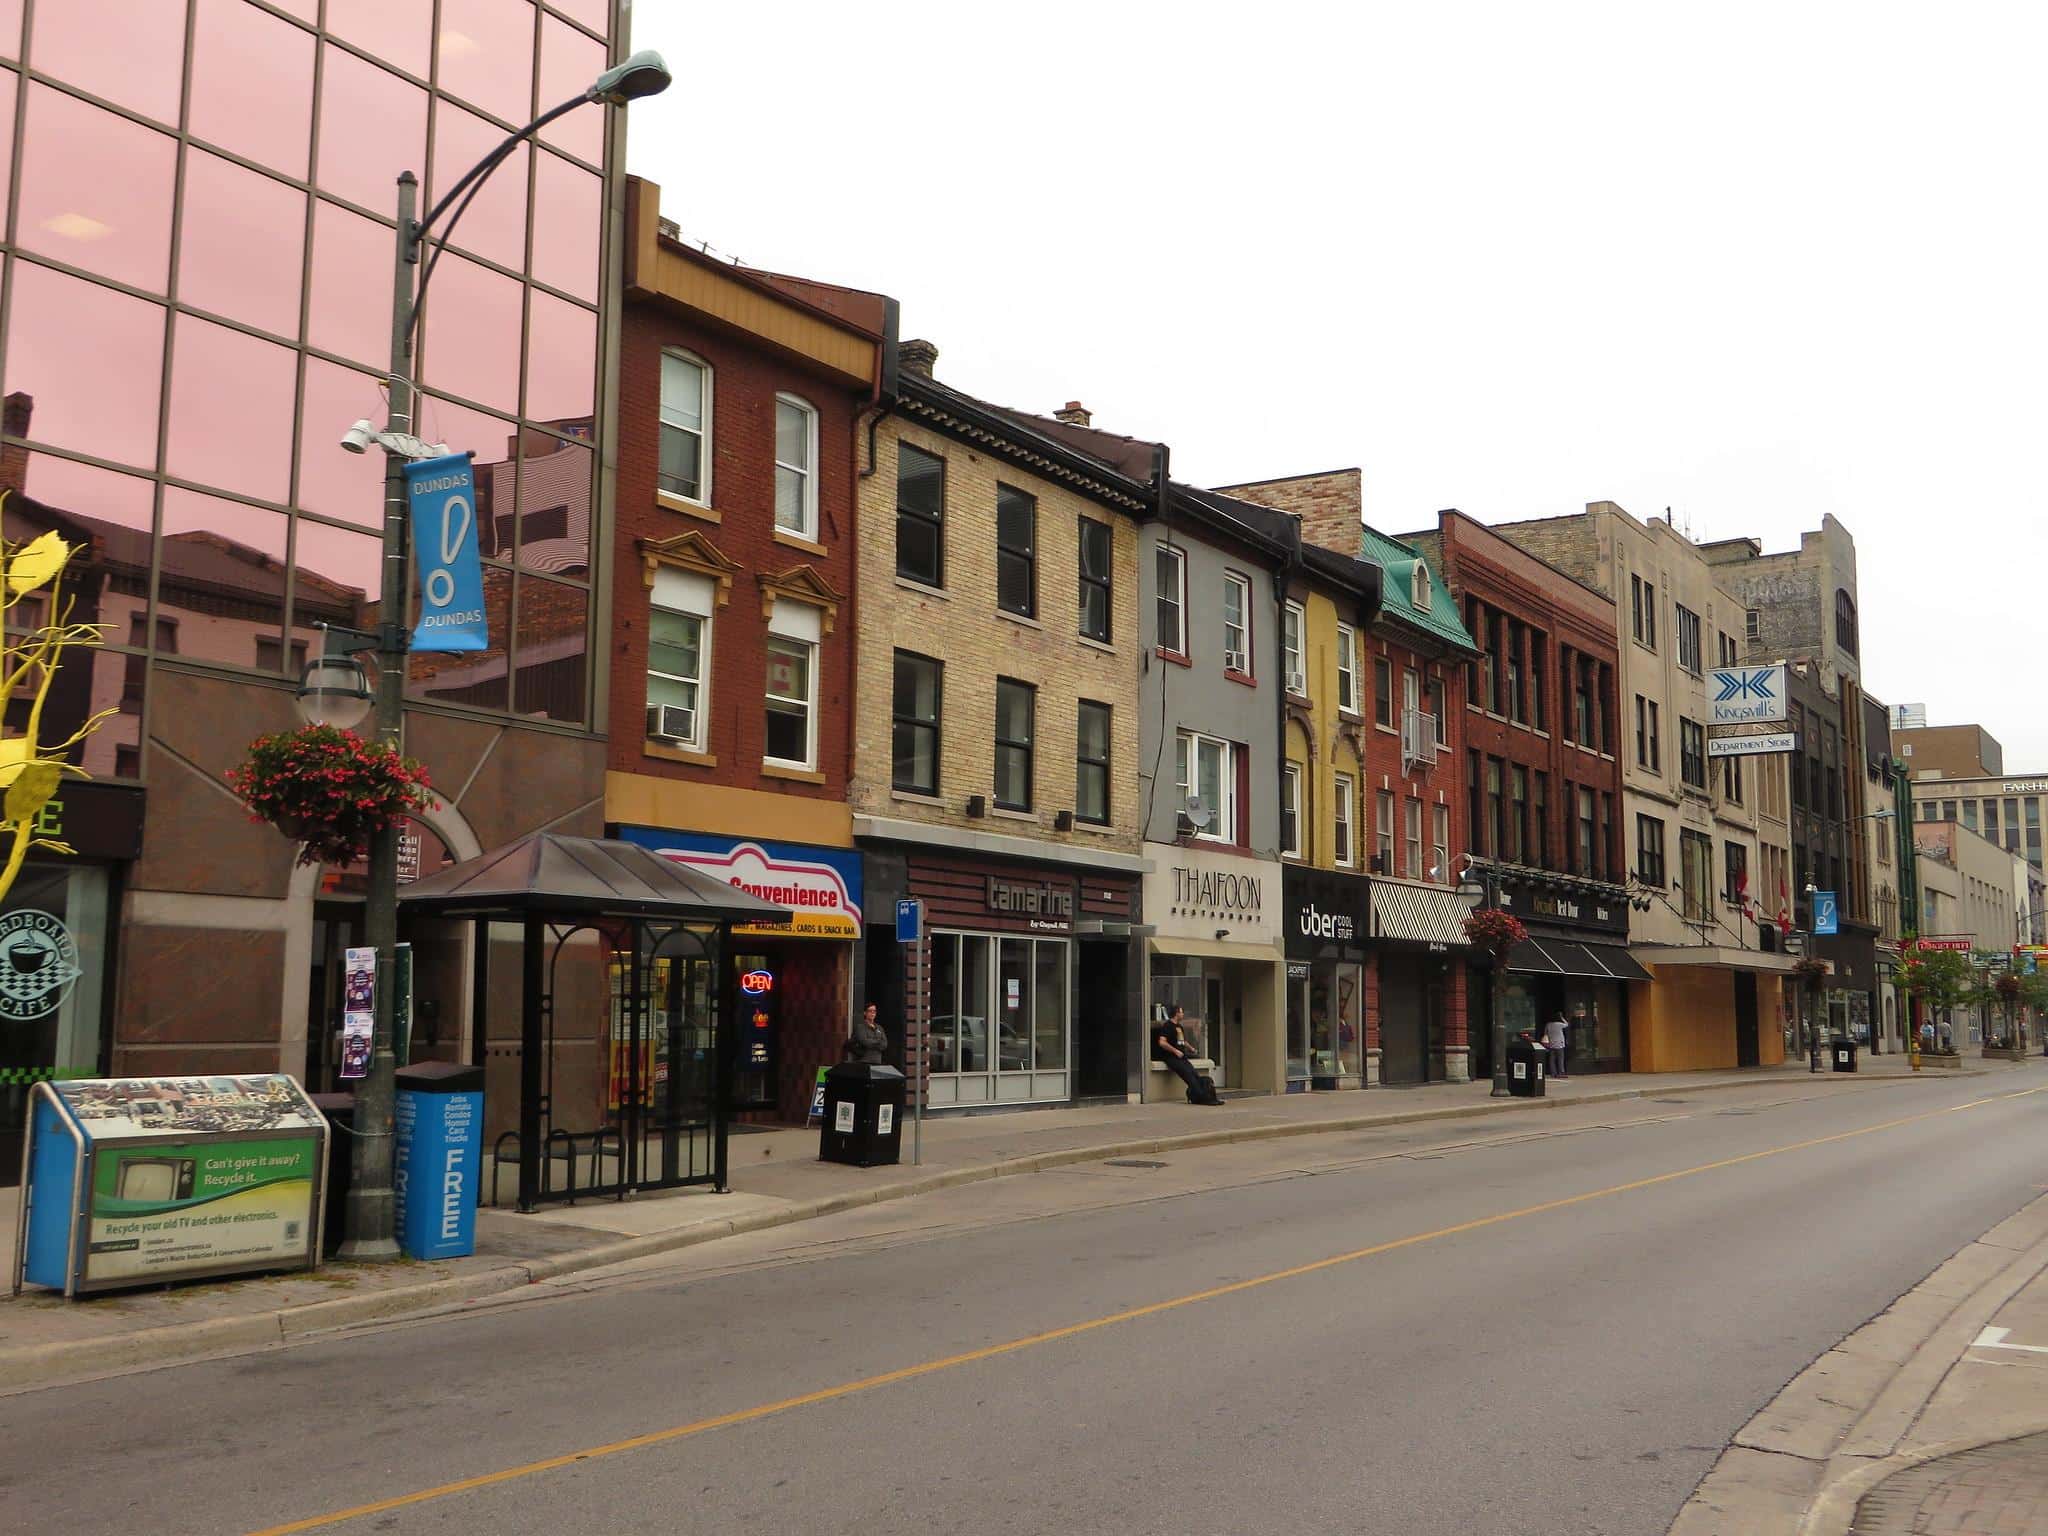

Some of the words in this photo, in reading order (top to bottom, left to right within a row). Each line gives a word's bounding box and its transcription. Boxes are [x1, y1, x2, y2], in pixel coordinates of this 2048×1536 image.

[414, 474, 469, 495] DUNDAS
[424, 610, 482, 628] DUNDAS
[1711, 739, 1764, 753] DEPARTMENT
[1767, 737, 1792, 747] STORE
[989, 876, 1073, 916] tamarine
[1171, 866, 1262, 911] THAIFOON
[1171, 906, 1262, 923] RESTAURANT
[1300, 904, 1336, 938] über
[1337, 915, 1353, 927] COOL
[797, 924, 816, 933] CARDS
[824, 925, 841, 934] SNACK
[843, 926, 855, 935] BAR
[1337, 929, 1353, 940] STUFF
[743, 974, 771, 990] OPEN
[0, 996, 51, 1014] CAFE
[444, 1111, 472, 1119] Condos
[444, 1135, 469, 1143] Trucks
[205, 1156, 233, 1169] Can't
[233, 1155, 257, 1170] give
[259, 1155, 267, 1166] it
[268, 1153, 301, 1167] away?
[204, 1172, 245, 1186] Recycle
[245, 1172, 257, 1182] it.
[442, 1149, 465, 1239] FREE
[105, 1222, 140, 1237] Recycle
[142, 1220, 163, 1234] your
[163, 1218, 178, 1229] old
[179, 1217, 189, 1228] TV
[191, 1216, 208, 1227] and
[209, 1214, 232, 1225] other
[233, 1211, 278, 1223] electronics.
